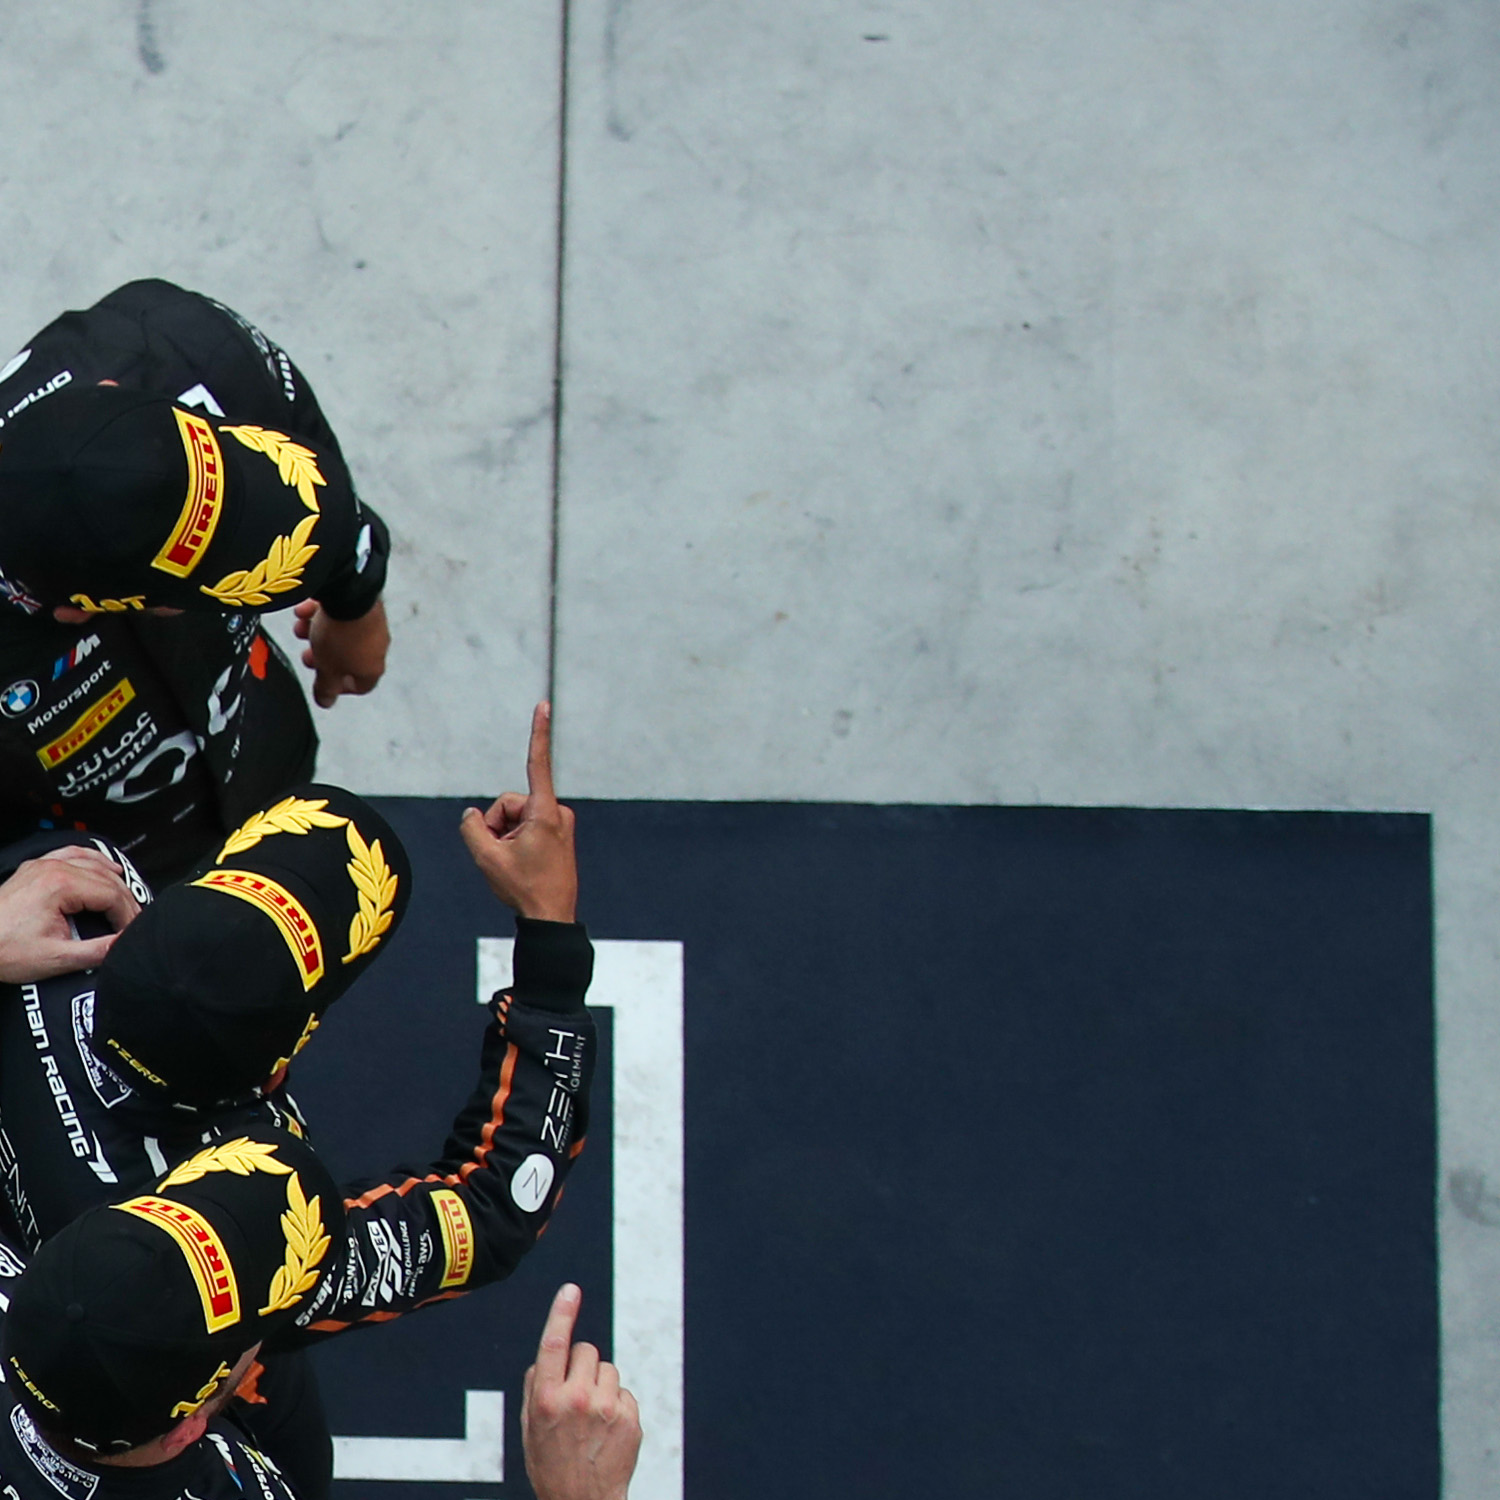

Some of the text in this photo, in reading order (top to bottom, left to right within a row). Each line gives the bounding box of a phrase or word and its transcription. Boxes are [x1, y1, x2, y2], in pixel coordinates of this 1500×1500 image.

[165, 418, 222, 568] PIRELLI
[26, 659, 113, 735] Motorsport
[47, 688, 127, 763] PIRELLI
[210, 873, 318, 974] PIRELLI
[21, 984, 50, 1050] man
[129, 1202, 237, 1315] PIRELLI
[379, 1218, 404, 1302] GT
[400, 1221, 412, 1267] CHALLENGE
[441, 1200, 468, 1278] PIRELLI
